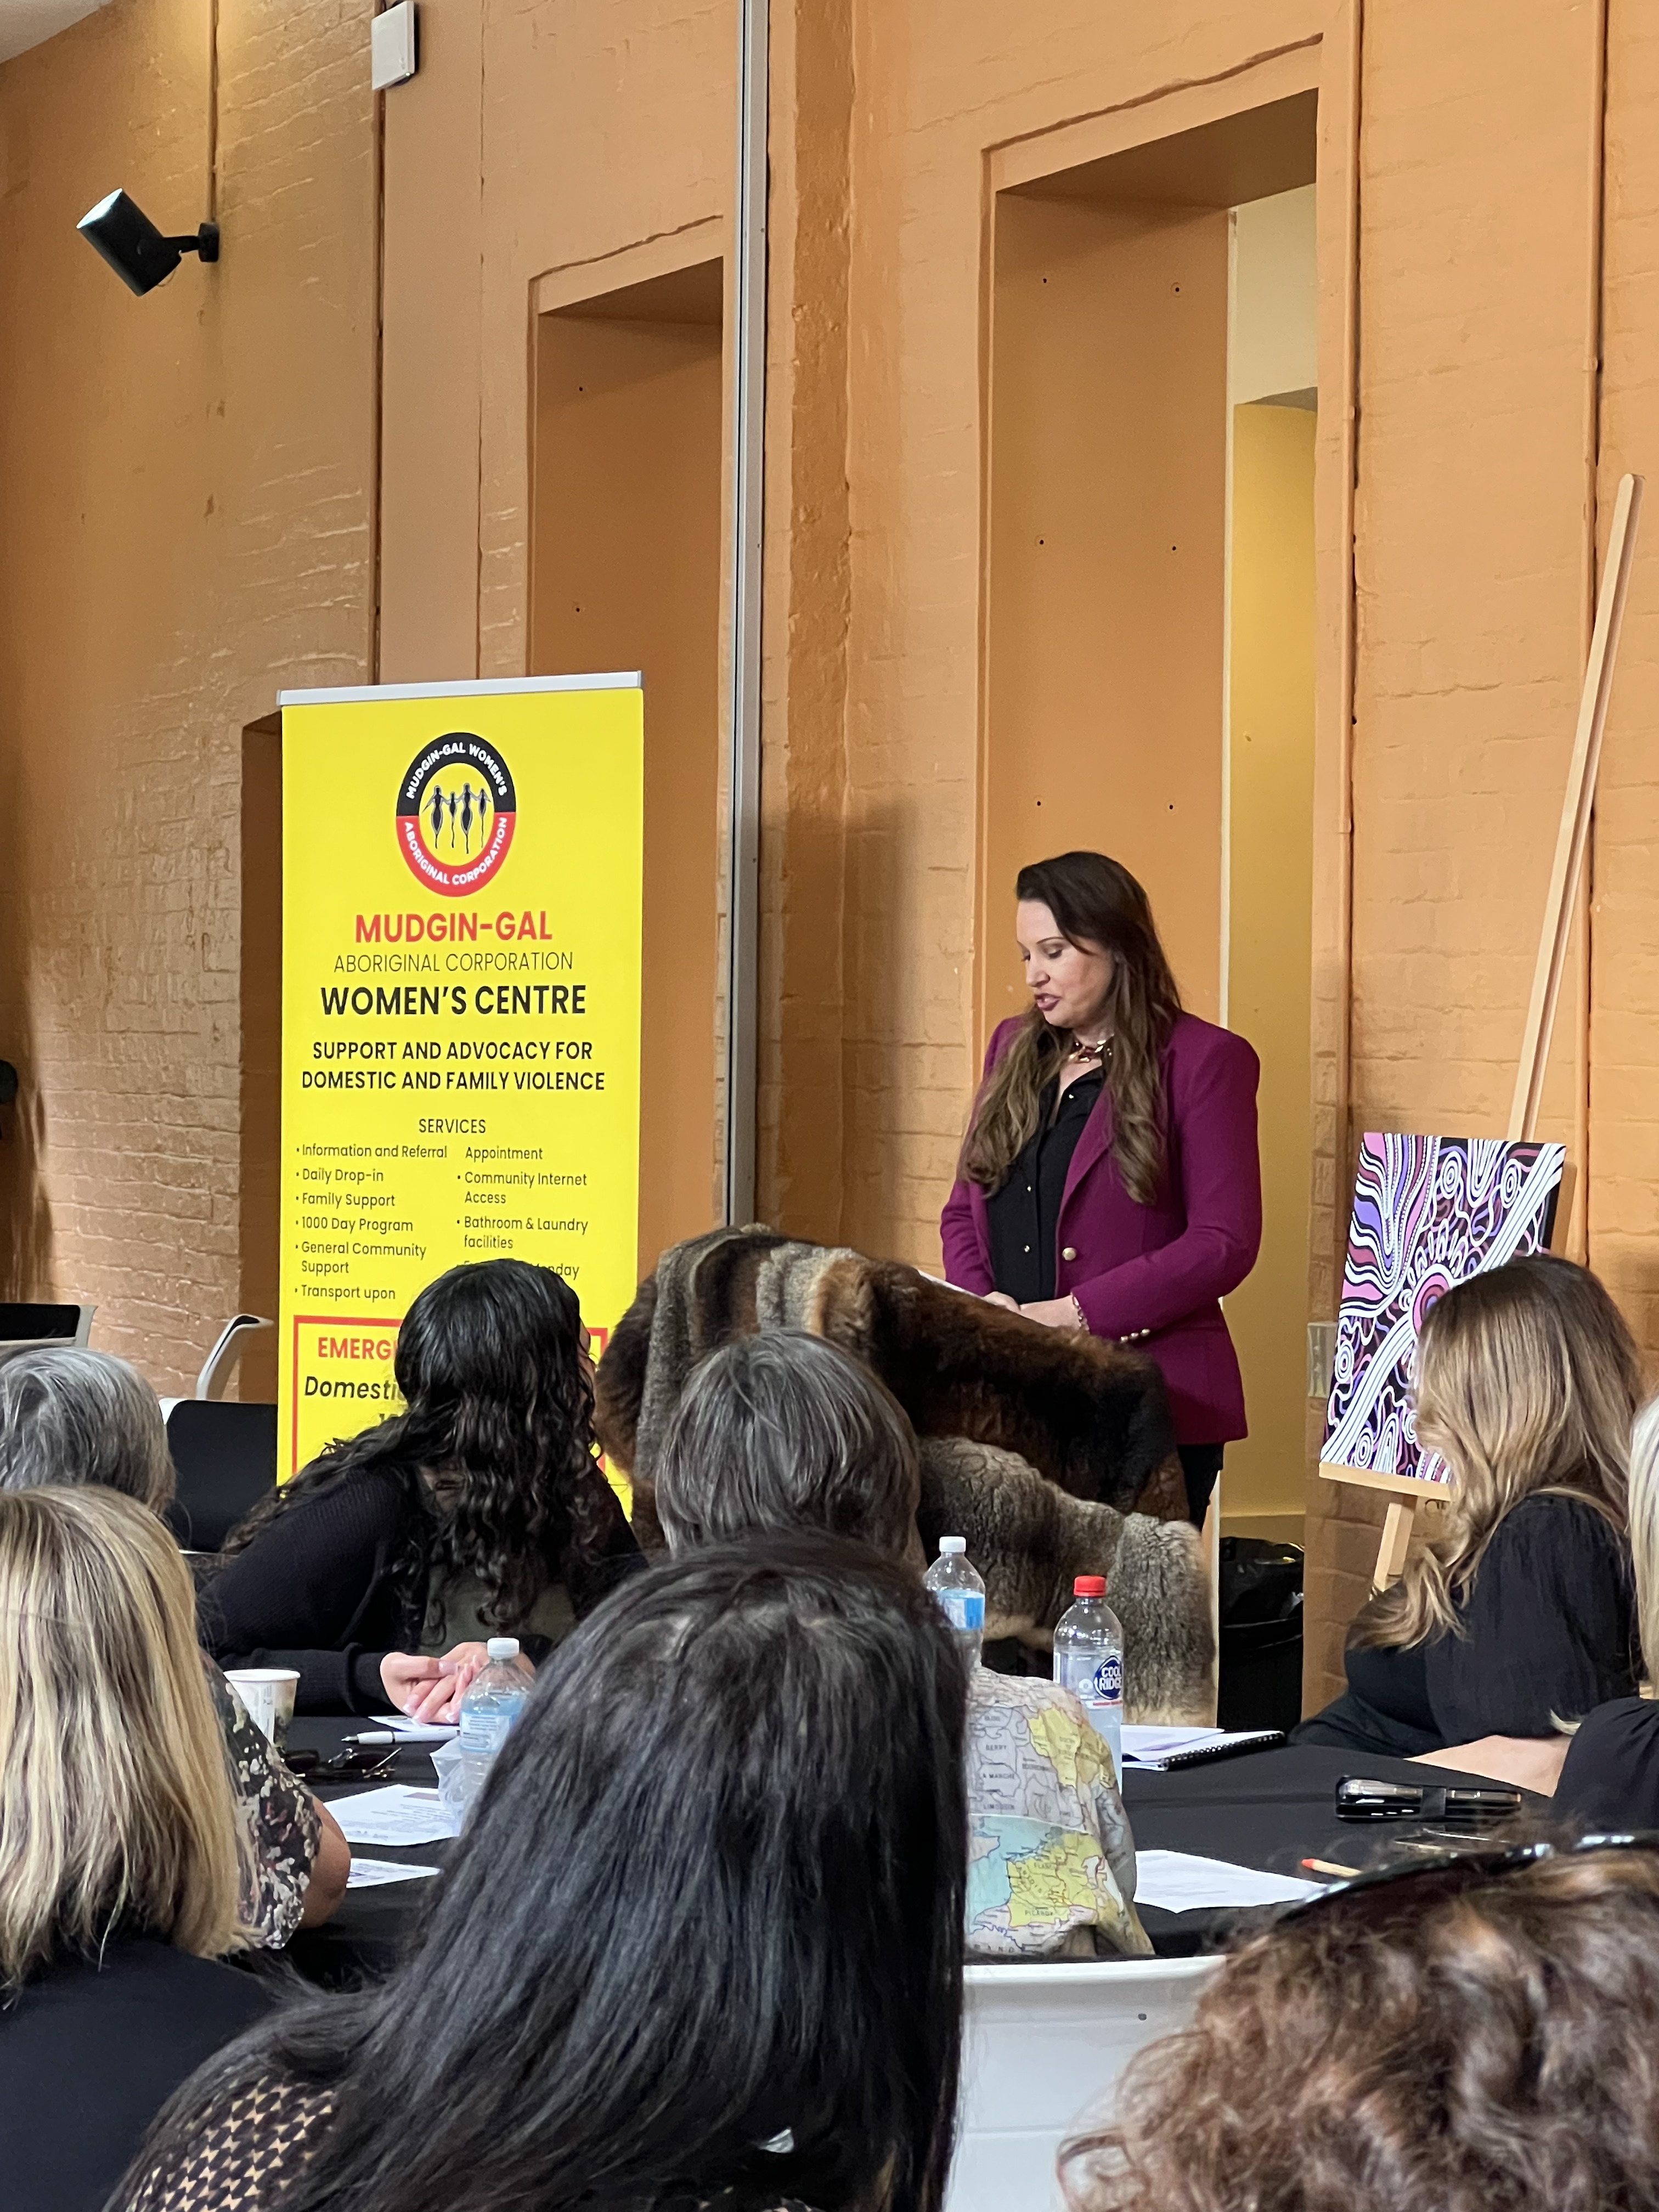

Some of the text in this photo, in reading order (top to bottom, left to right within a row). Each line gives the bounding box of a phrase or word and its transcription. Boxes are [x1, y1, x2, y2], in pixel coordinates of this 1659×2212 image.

[406, 742, 508, 800] MUDGIN-GAL WOMEN'S
[405, 816, 507, 885] ABORIGINAL CORPORATION
[355, 910, 553, 943] MUDGIN-GAL
[334, 951, 573, 973] ABORIGINAL CORPORATION
[320, 984, 586, 1015] WOMEN'S CENTRE
[313, 1041, 592, 1060] SUPPORT AND ADVOCACY FOR
[302, 1071, 605, 1091] DOMESTIC AND FAMILY VIOLENCE
[419, 1118, 486, 1134] SERVICES
[302, 1143, 448, 1158] Information and Referral
[465, 1145, 543, 1163] Appointment
[302, 1167, 384, 1186] Daily Drop-in
[465, 1171, 587, 1189] Community Internet
[302, 1192, 396, 1210] Family Support
[464, 1190, 506, 1204] Access
[302, 1216, 413, 1235] 1000 Day Program
[464, 1215, 589, 1235] Bathroom & Laundry
[301, 1241, 427, 1261] General Community
[464, 1234, 514, 1249] facilities
[301, 1260, 349, 1277] Support
[537, 1263, 579, 1280] nday
[301, 1284, 396, 1303] Transport upon
